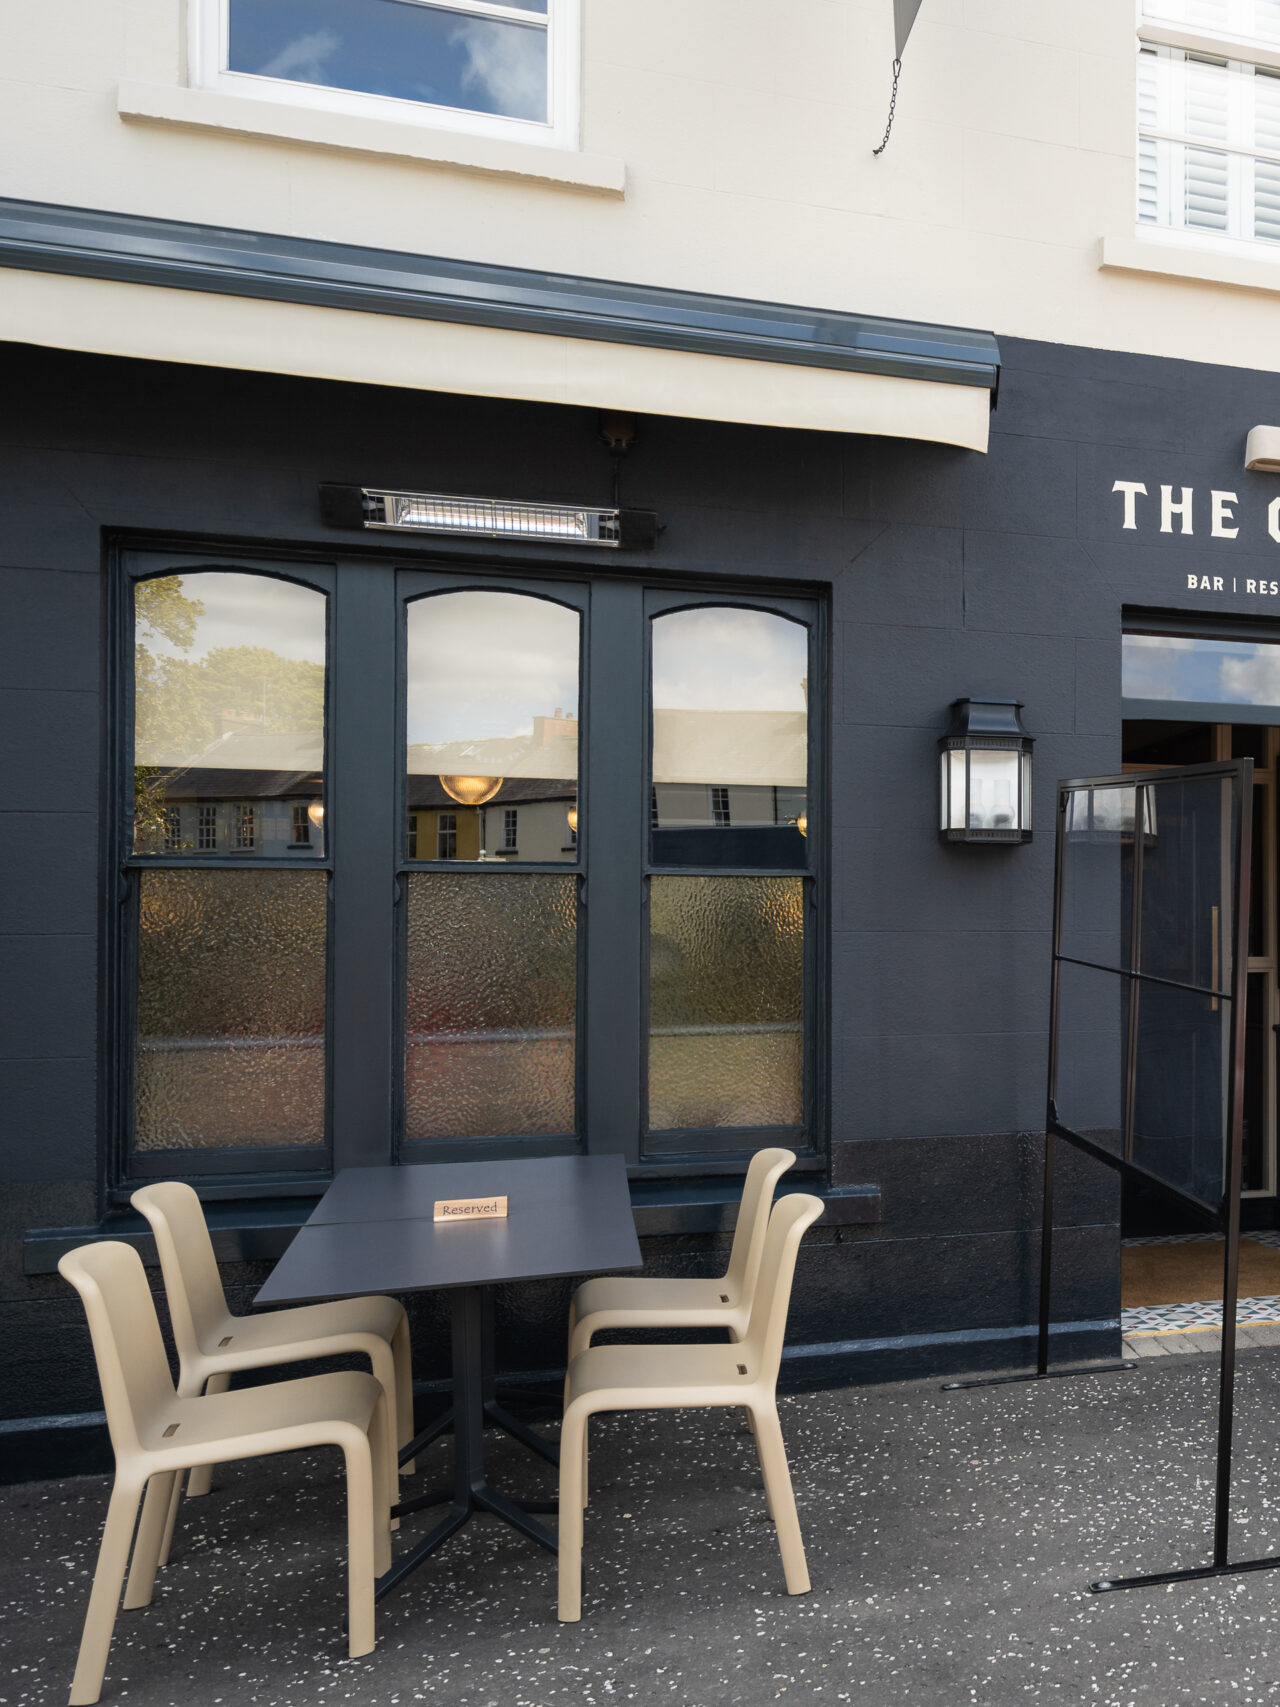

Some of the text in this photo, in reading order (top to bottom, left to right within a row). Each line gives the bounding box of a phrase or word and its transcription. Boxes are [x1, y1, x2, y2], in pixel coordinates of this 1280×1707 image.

[1112, 480, 1240, 539] THE
[1187, 574, 1224, 592] BAR
[442, 1201, 498, 1215] Reserved
